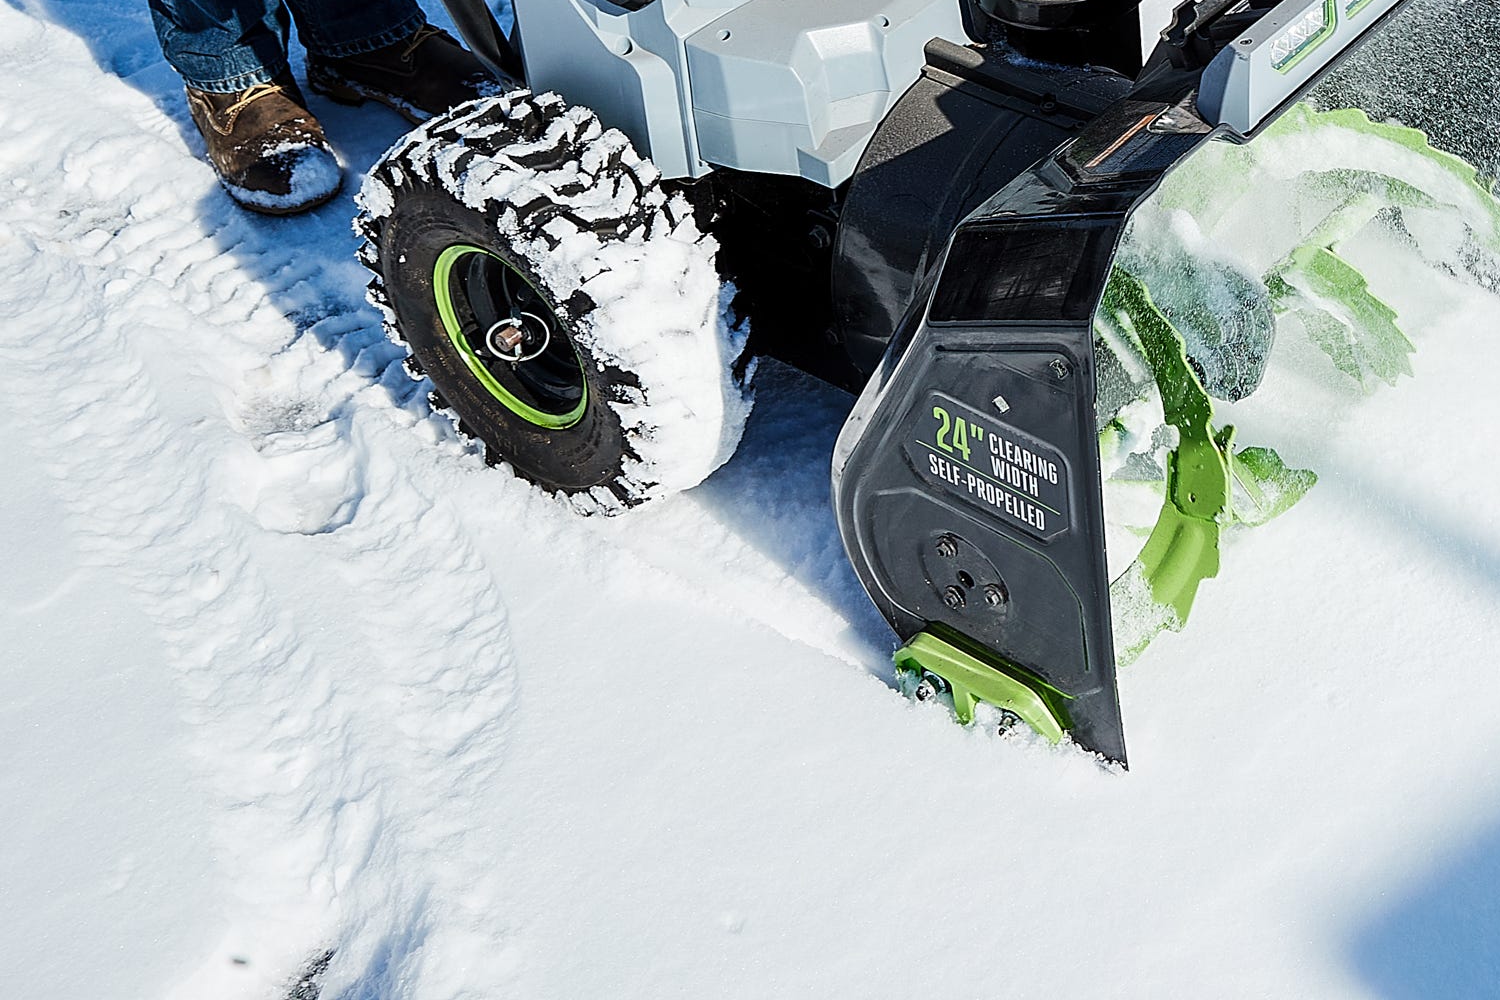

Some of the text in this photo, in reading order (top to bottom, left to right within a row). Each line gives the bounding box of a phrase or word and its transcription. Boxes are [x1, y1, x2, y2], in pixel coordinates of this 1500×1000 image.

[932, 406, 984, 461] 24"
[989, 433, 1058, 485] CLEARING
[928, 453, 1046, 531] SELF-PROPELLED
[990, 456, 1039, 498] WIDTH
